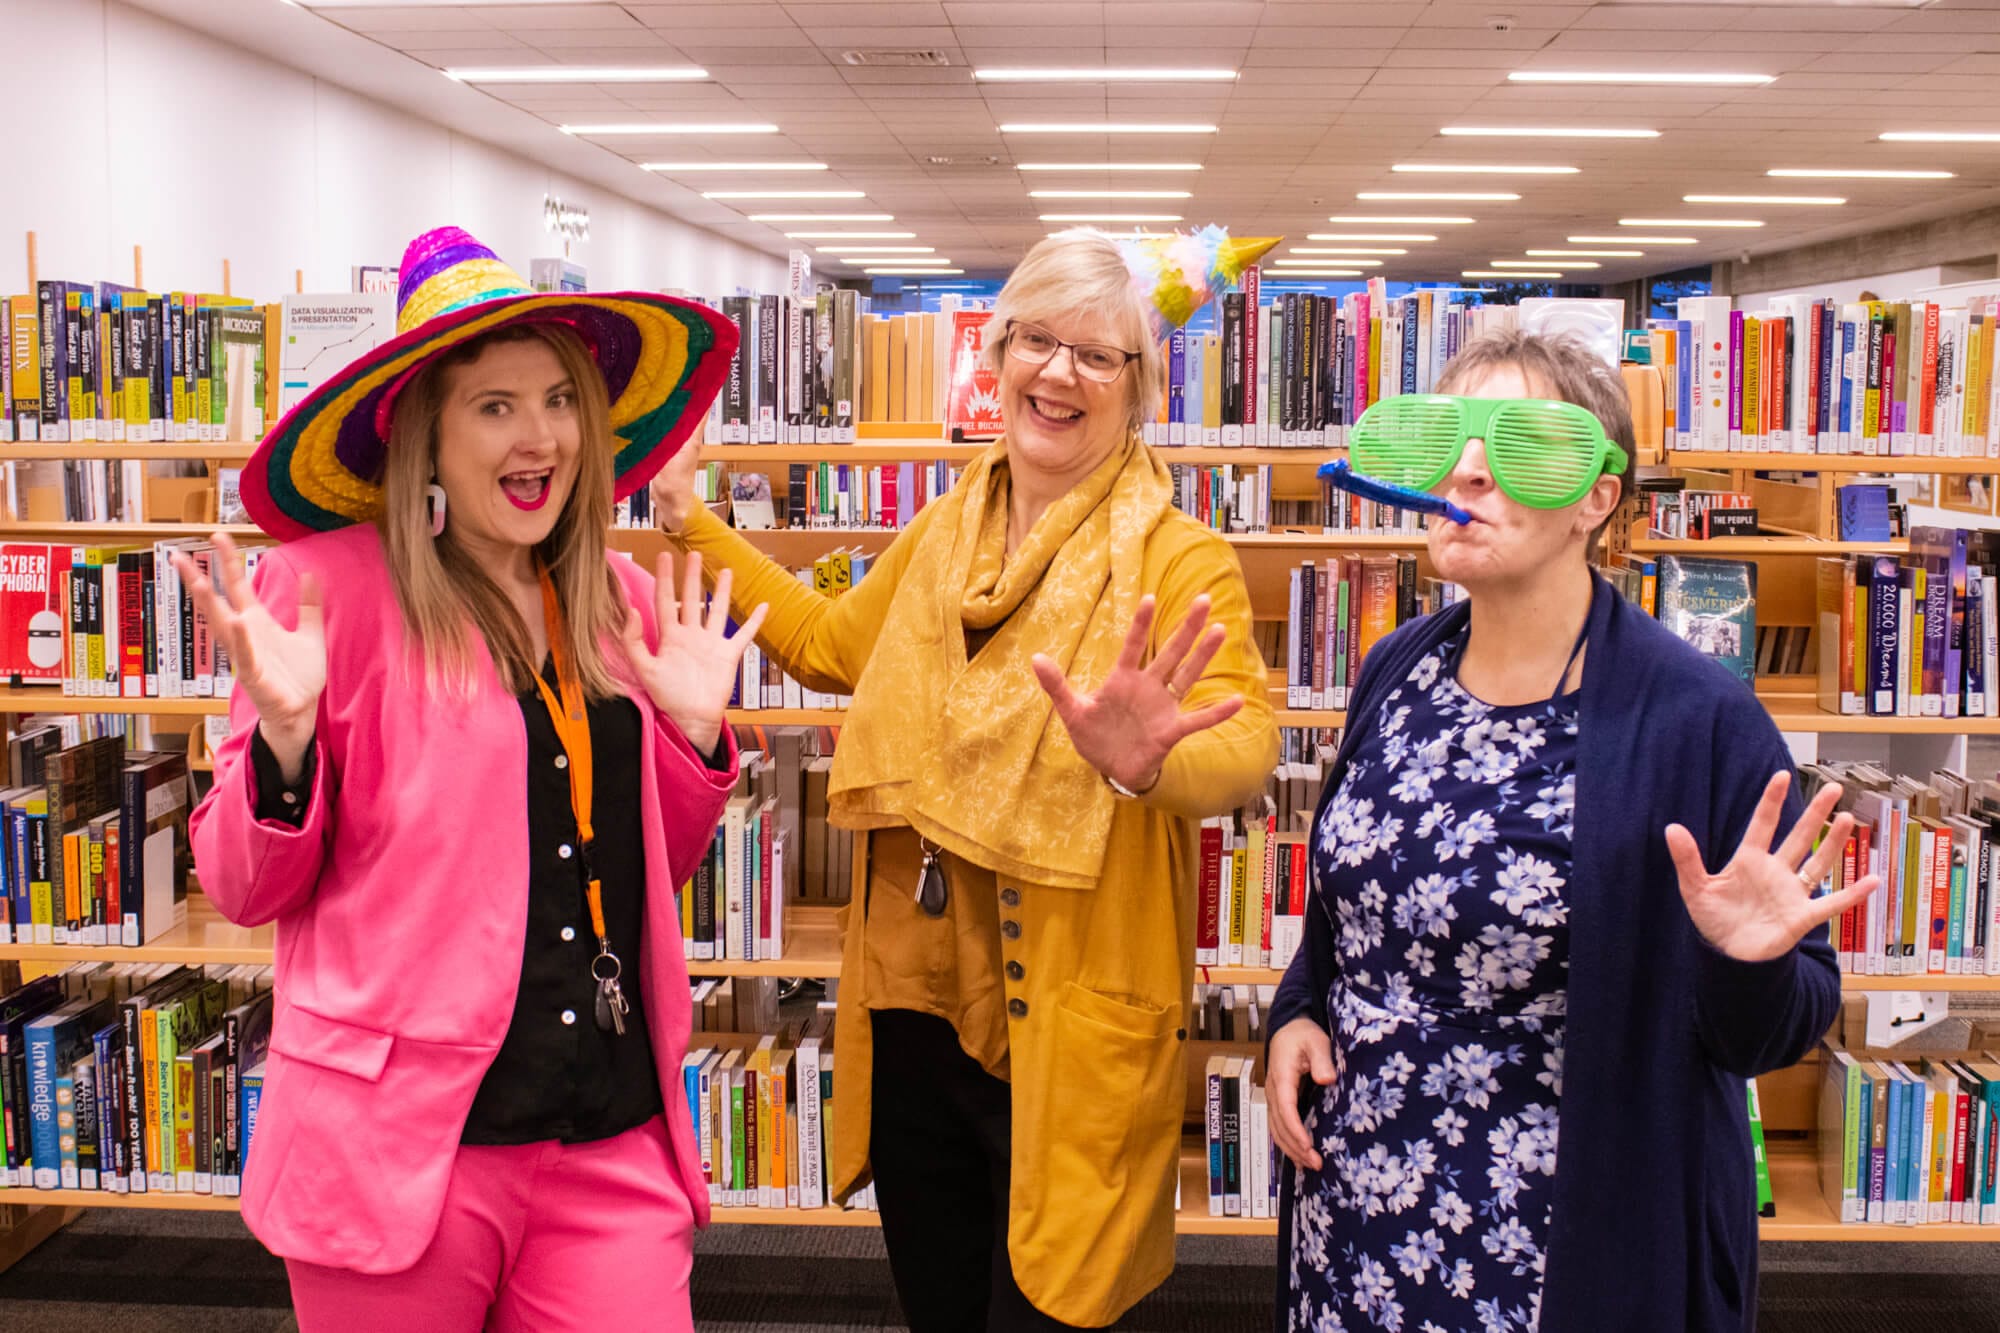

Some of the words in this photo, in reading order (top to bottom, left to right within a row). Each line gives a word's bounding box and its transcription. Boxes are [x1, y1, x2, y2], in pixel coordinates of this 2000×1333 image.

[791, 260, 800, 290] TIMES
[1247, 271, 1255, 313] BUCKLAND'S
[43, 304, 53, 342] Microsoft
[291, 308, 310, 316] DATA
[313, 307, 373, 316] VISUALIZATION
[299, 315, 358, 324] PRESENTATION
[1287, 297, 1295, 324] KELVIN
[1303, 299, 1311, 325] KELVIN
[1406, 302, 1417, 348] JOURNEY
[1927, 307, 1938, 328] 100
[14, 313, 38, 371] Linux
[132, 320, 143, 345] Excel
[791, 307, 800, 351] CHANGE
[1873, 323, 1882, 345] Body
[45, 344, 56, 369] Office
[132, 347, 142, 370] 2016
[1173, 335, 1184, 354] PETS
[1247, 338, 1255, 359] SPIRIT
[1286, 324, 1295, 377] CRUICKSHANK
[1302, 326, 1311, 377] CRUICKSHANK
[1406, 350, 1416, 364] OF
[1749, 335, 1758, 366] DEADLY
[1926, 330, 1936, 365] THINGS
[1871, 345, 1881, 386] Language
[45, 369, 56, 409] 2013/365
[730, 363, 740, 408] MARKET
[1246, 360, 1254, 423] COMMUNICATIONS
[1747, 368, 1758, 419] WANDERING
[1713, 515, 1726, 525] THE
[1727, 515, 1754, 525] PEOPLE
[0, 554, 46, 574] CYBER
[0, 573, 46, 593] PHOBIA
[73, 577, 82, 603] Access
[88, 583, 97, 604] Access
[1926, 584, 1935, 639] DICTIONARY
[1934, 584, 1946, 639] DREAM
[167, 594, 178, 673] SUPERINTELLIGENCE
[184, 616, 192, 640] Garry
[184, 641, 193, 680] Kasparov
[1880, 632, 1897, 688] Dreams
[14, 815, 25, 835] Ajax
[90, 843, 103, 874] 500
[1206, 849, 1218, 878] THE
[1264, 832, 1274, 895] PUZZILLUSIONS
[1935, 835, 1949, 889] BRAINSTORM
[1206, 879, 1218, 905] RED
[1234, 866, 1243, 889] PSYCH
[1205, 905, 1218, 941] BOOK
[1232, 890, 1242, 938] EXPERIMENTS
[31, 1042, 52, 1121] knowledge
[160, 1060, 169, 1089] Believe
[1209, 1079, 1219, 1099] JON
[84, 1083, 94, 1125] TALES
[1876, 1085, 1885, 1099] The
[74, 1081, 89, 1140] weird
[161, 1110, 171, 1128] Not!
[747, 1099, 756, 1124] FENG
[1210, 1100, 1221, 1139] RONSON
[130, 1117, 139, 1138] 100
[747, 1125, 755, 1147] SHUI
[1223, 1113, 1238, 1143] FEAR
[747, 1159, 755, 1188] MONEY
[809, 1161, 818, 1190] MAGIC
[1873, 1153, 1885, 1201] HOLFOR
